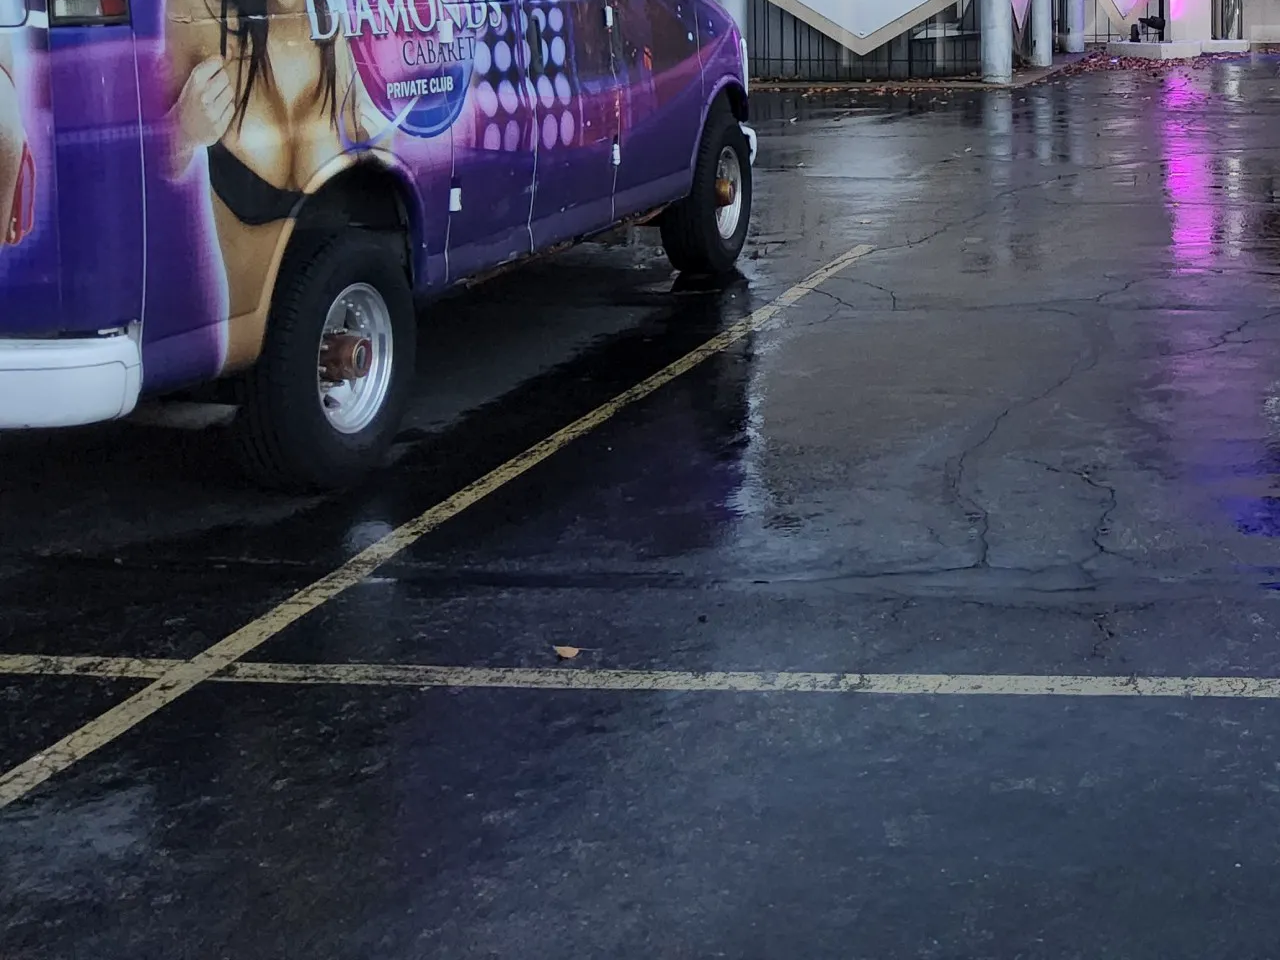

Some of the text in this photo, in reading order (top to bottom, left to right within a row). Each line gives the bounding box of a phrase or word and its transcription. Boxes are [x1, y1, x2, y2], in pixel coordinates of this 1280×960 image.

[402, 36, 475, 66] CABARET
[387, 76, 454, 99] PRIVATE CLUB
